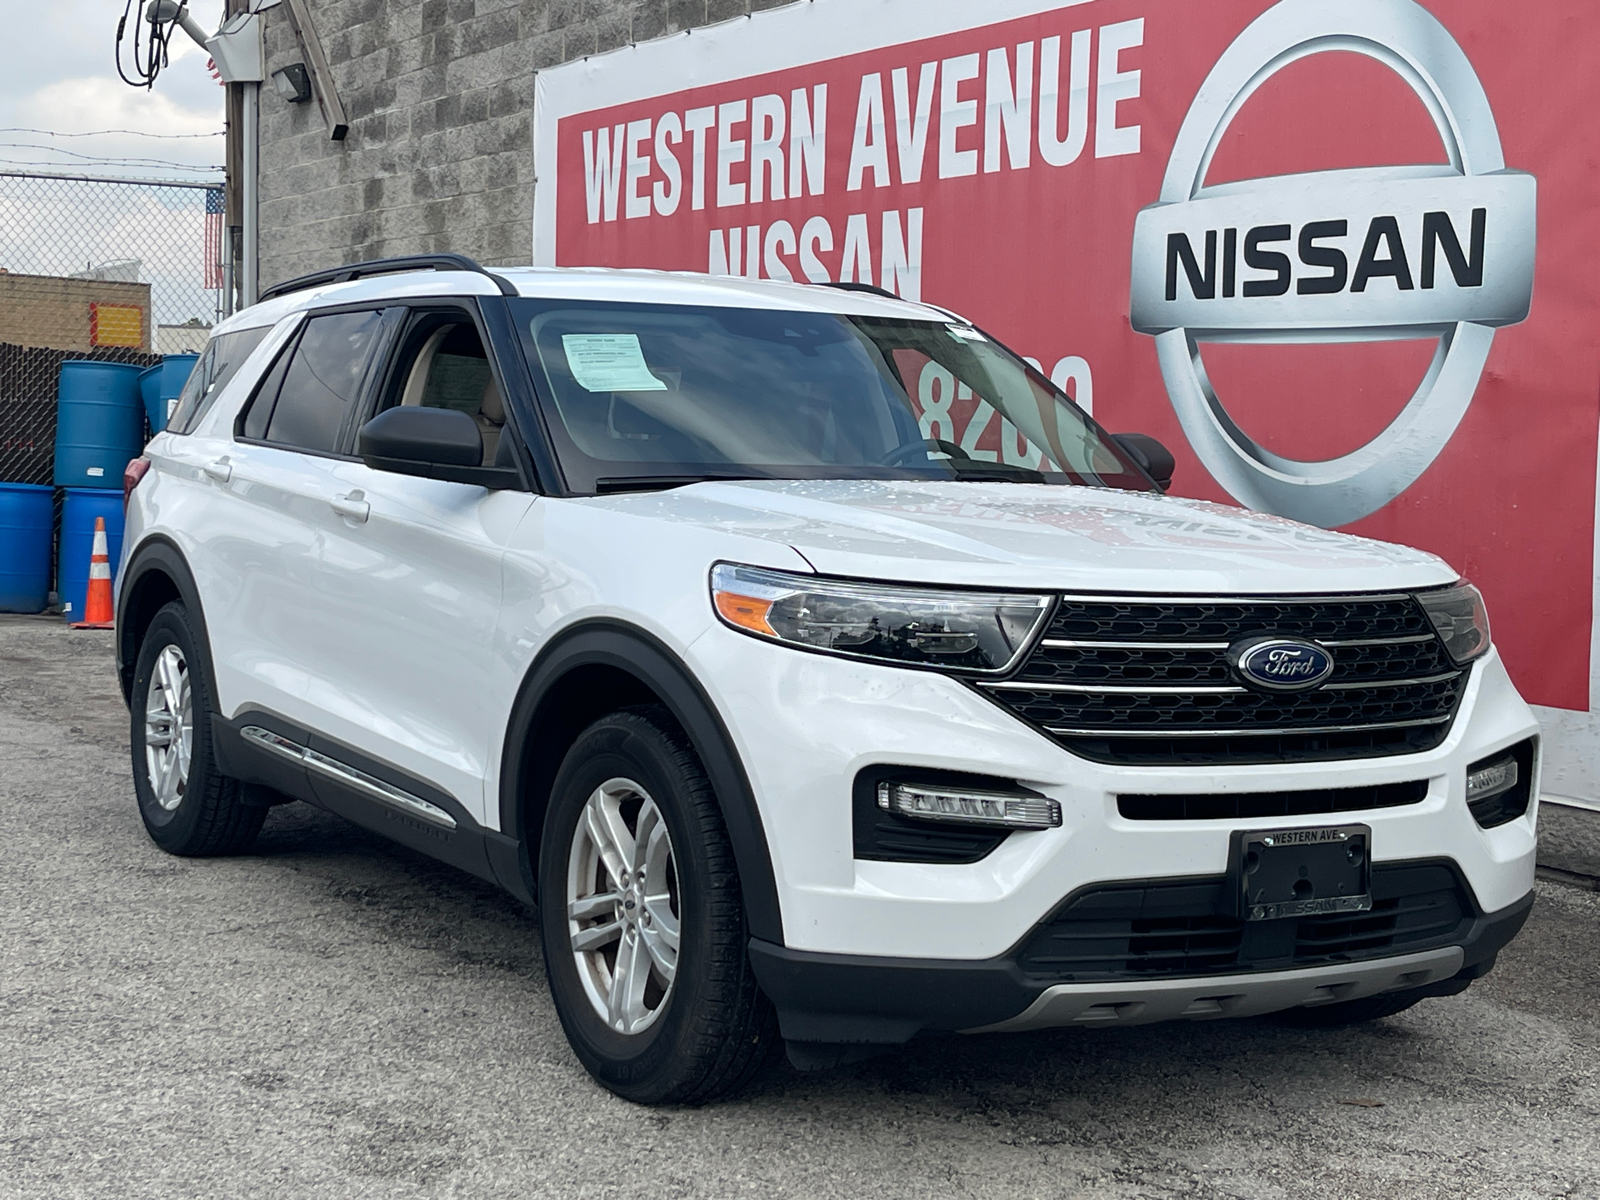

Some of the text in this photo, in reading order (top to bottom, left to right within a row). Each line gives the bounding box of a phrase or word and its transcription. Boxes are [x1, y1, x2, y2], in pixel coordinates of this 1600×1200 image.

[582, 17, 1145, 224] WESTERN AVENUE
[708, 207, 924, 303] NISSAN
[1165, 208, 1487, 301] NISSAN
[1265, 649, 1315, 675] Ford
[1273, 831, 1318, 844] WESTERN
